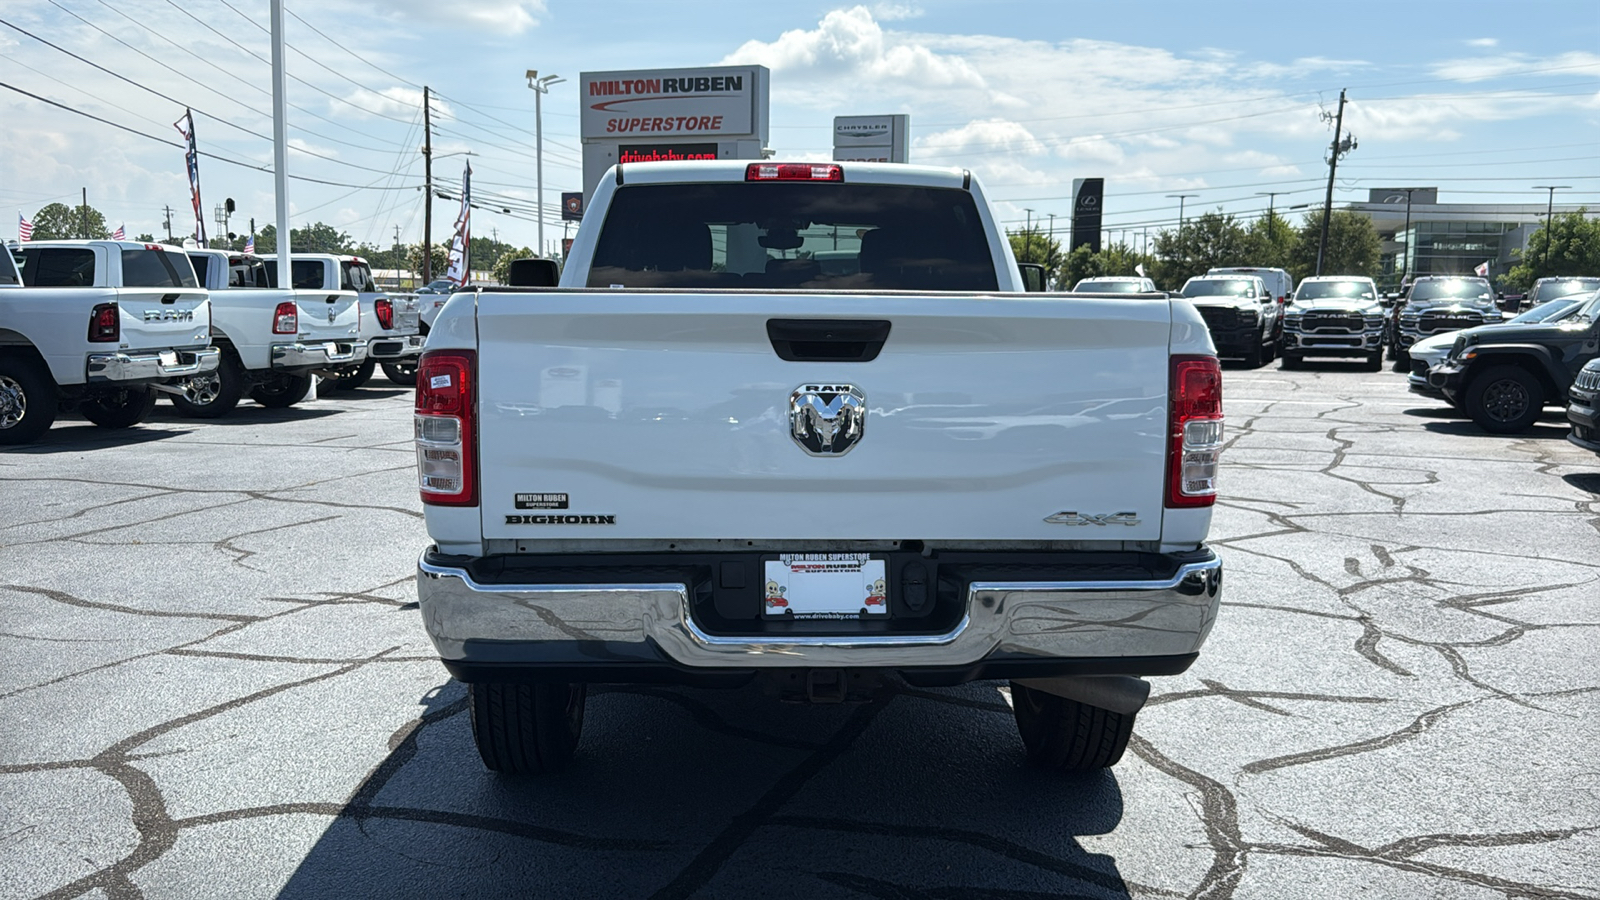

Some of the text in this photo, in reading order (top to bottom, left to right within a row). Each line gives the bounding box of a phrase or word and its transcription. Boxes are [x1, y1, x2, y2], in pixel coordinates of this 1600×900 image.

[589, 76, 743, 96] MILTON RUBEN
[606, 116, 724, 133] SUPERSTORE
[620, 149, 716, 164] drivebabcom
[143, 308, 194, 325] RAM
[516, 494, 567, 502] MILTON RUBEN
[505, 515, 616, 525] BIGHORN
[779, 553, 870, 561] MILTON RUBEN SUPERSTORE
